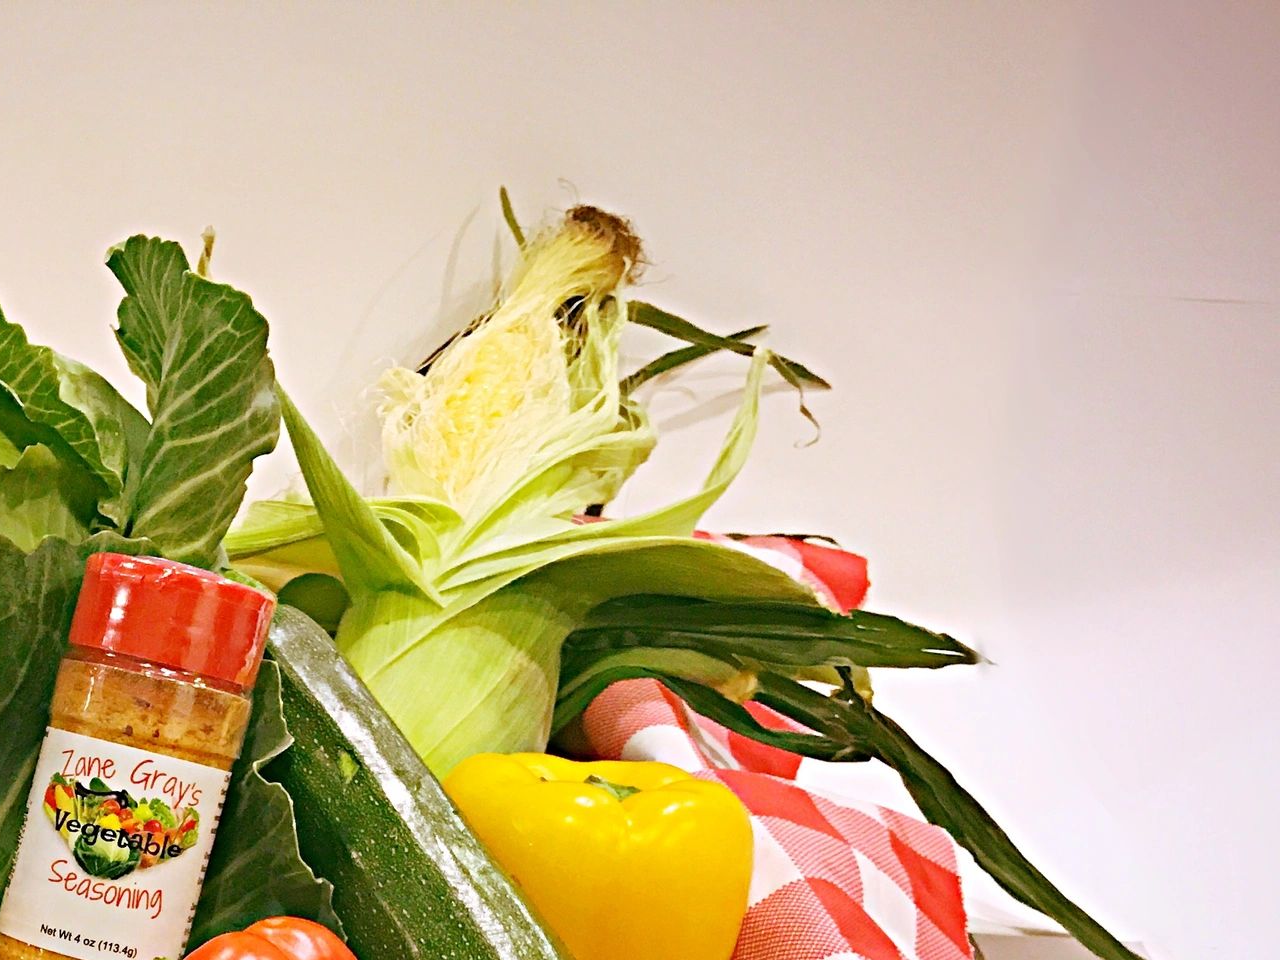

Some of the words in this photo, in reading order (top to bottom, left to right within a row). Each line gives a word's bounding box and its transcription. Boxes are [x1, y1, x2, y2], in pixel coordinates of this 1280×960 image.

[60, 749, 117, 779] Zane
[129, 758, 203, 809] Gray's
[54, 807, 184, 859] Vegetable
[47, 859, 163, 920] Seasoning
[40, 923, 57, 937] Net
[58, 928, 73, 942] Wt
[73, 934, 81, 944] 4
[82, 938, 96, 948] oz
[97, 940, 138, 959] (113.4g)
